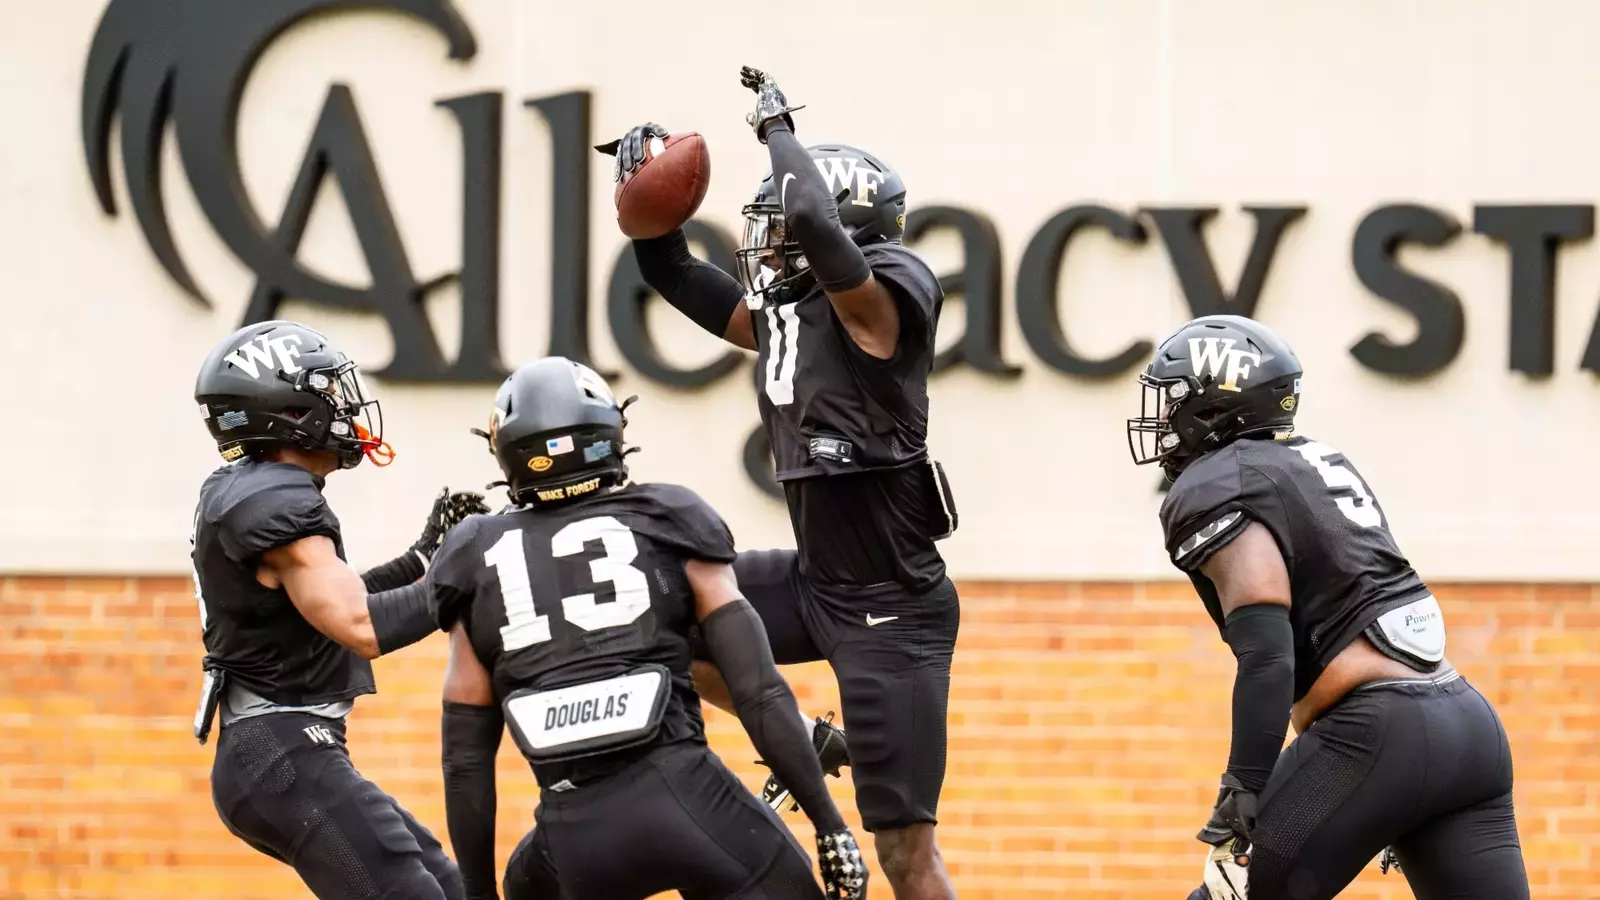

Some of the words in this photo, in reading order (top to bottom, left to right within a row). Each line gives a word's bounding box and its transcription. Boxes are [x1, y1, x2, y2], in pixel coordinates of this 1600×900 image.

[813, 157, 884, 207] WF
[240, 80, 1308, 498] Alleacy
[1348, 202, 1600, 382] ST
[224, 334, 302, 379] WF
[1188, 337, 1260, 392] WF
[537, 488, 565, 501] WAKE
[565, 477, 601, 497] FOREST
[1288, 441, 1382, 528] 5
[484, 516, 651, 651] 13
[303, 724, 336, 744] WF
[544, 692, 628, 731] DOUGLAS
